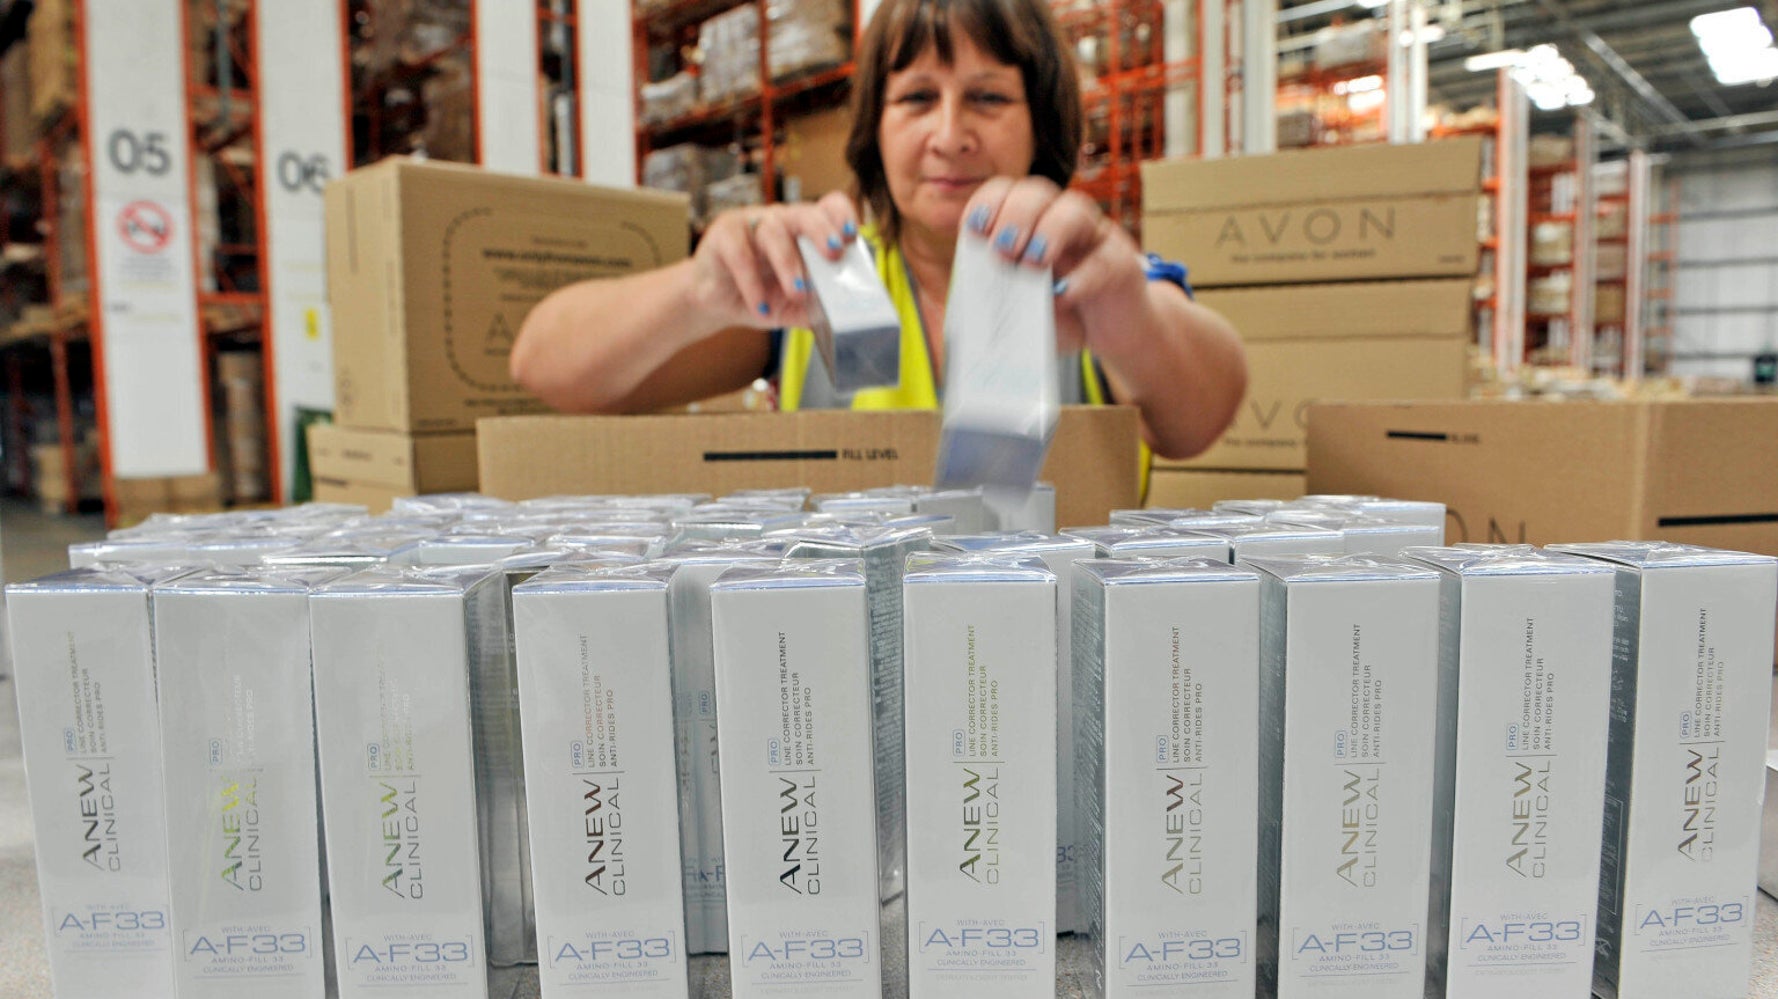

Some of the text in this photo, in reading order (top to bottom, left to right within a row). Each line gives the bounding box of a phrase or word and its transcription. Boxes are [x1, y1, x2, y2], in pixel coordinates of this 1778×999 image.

[108, 129, 171, 176] 05
[278, 151, 330, 193] 06
[1215, 206, 1396, 248] AVON
[779, 632, 789, 684] TREATMENT
[1353, 624, 1361, 676] TREATMENT
[1525, 618, 1534, 669] TREATMENT
[606, 689, 615, 710] PRO
[804, 687, 812, 708] PRO
[968, 679, 976, 734] CORRECTOR
[1172, 626, 1180, 763] LINE CORRECTOR TREATMENT
[1195, 683, 1203, 703] PRO
[1351, 679, 1359, 735] CORRECTOR
[1362, 665, 1371, 730] CORRECTEUR
[1374, 680, 1382, 700] PRO
[1523, 672, 1532, 728] CORRECTOR
[1534, 658, 1544, 723] CORRECTEUR
[1546, 673, 1554, 693] PRO
[583, 690, 594, 746] CORRECTOR
[781, 687, 790, 743] CORRECTOR
[792, 672, 803, 765] SOIN CORRECTEUR
[1509, 725, 1517, 748] PRO
[211, 740, 220, 762] PRO
[369, 745, 378, 768] PRO
[587, 749, 595, 768] LINE
[598, 743, 606, 767] SOIN
[770, 741, 778, 764] PRO
[955, 732, 963, 754] PRO
[1337, 733, 1345, 756] PRO
[76, 764, 105, 870] ANEW
[100, 763, 121, 872] CLINICAL
[959, 768, 981, 883] ANEW
[986, 767, 999, 885] CLINICAL
[1336, 770, 1361, 888] ANEW
[1363, 768, 1380, 888] CLINICAL
[1506, 762, 1533, 878] ANEW
[1533, 760, 1550, 879] CLINICAL
[1677, 749, 1703, 862] ANEW
[1701, 747, 1720, 863] CLINICAL
[221, 775, 244, 891] ANEW
[245, 777, 262, 892] CLINICAL
[380, 782, 405, 898] ANEW
[404, 780, 423, 899] CLINICAL
[583, 780, 608, 896] ANEW
[607, 778, 626, 896] CLINICAL
[779, 777, 802, 895] ANEW
[803, 776, 821, 895] CLINICAL
[1161, 774, 1184, 894] ANEW
[1189, 773, 1202, 895] CLINICAL
[59, 911, 165, 931] A-F33
[925, 928, 1039, 947] A-F33
[1297, 930, 1413, 953] A-F33
[1466, 921, 1580, 943] A-F33
[1640, 903, 1743, 929] A-F33
[190, 933, 306, 955] A-F33
[353, 942, 468, 963] A-F33
[555, 938, 670, 962] A-F33
[748, 938, 863, 961] A-F33
[1124, 938, 1241, 963] A-F33
